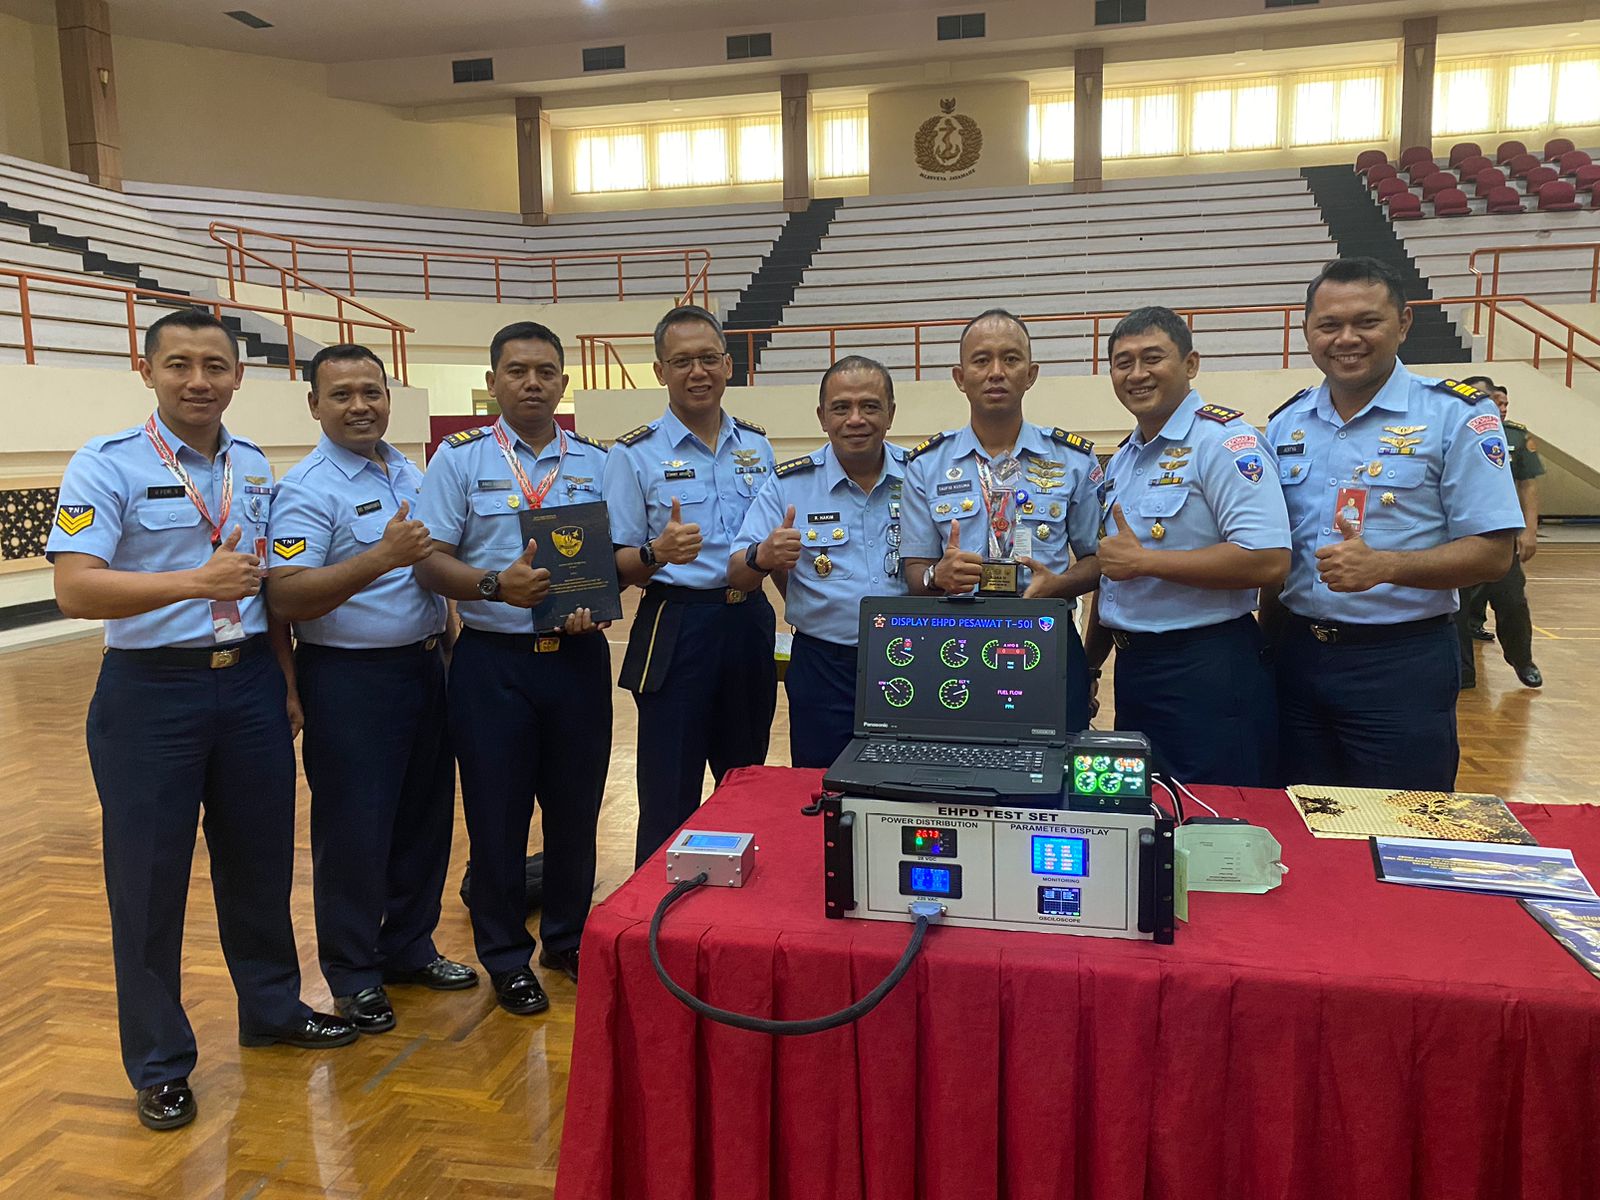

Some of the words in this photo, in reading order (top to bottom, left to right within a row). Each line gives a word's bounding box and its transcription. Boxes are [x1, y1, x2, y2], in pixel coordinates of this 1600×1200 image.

[891, 617, 928, 627] DISPLAY
[931, 618, 956, 627] EHPD
[958, 618, 1002, 628] PESAWAT
[938, 806, 979, 818] EHPD
[984, 809, 1023, 820] TEST
[1028, 812, 1059, 822] SET
[881, 816, 914, 825] POWER
[916, 818, 978, 829] DISTRIBUTION
[1010, 823, 1068, 834] PARAMETER
[1070, 826, 1109, 837] DISPLAY
